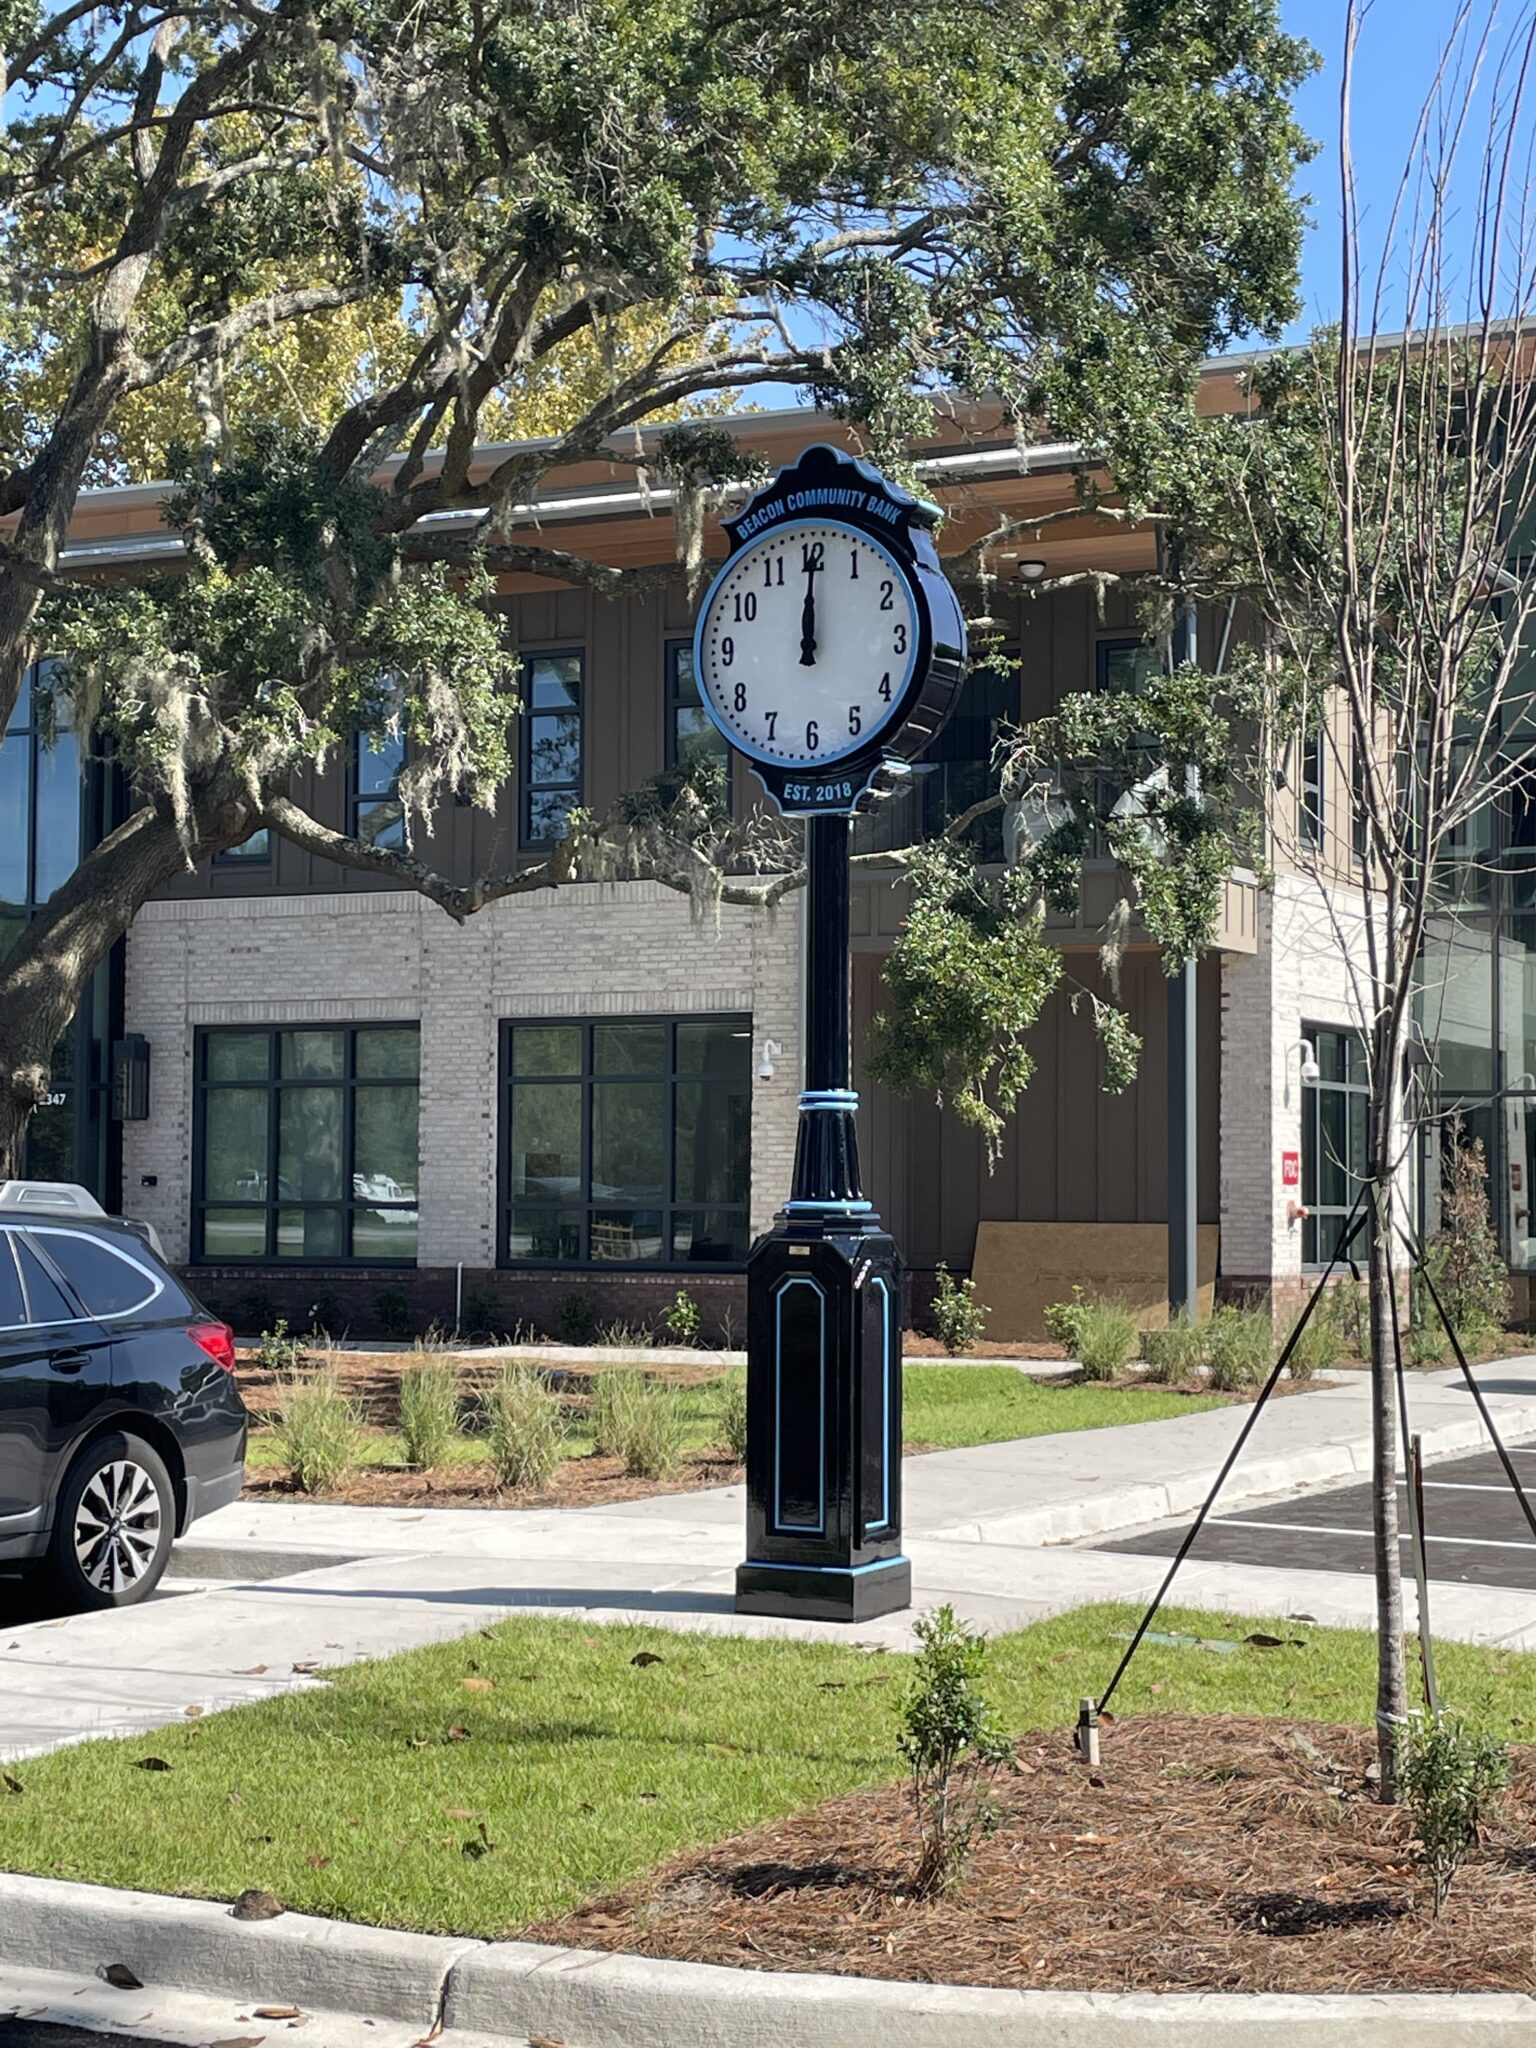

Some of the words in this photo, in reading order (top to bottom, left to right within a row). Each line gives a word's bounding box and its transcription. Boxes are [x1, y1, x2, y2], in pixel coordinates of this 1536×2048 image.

[736, 499, 785, 540] BEACON
[787, 488, 867, 511] COMMUNITY
[866, 496, 902, 525] BANK
[764, 556, 784, 587] 11
[801, 542, 824, 573] 12
[850, 549, 858, 579] 1
[734, 592, 757, 622] 10
[880, 580, 893, 610] 2
[721, 637, 734, 667] 9
[893, 624, 906, 655] 3
[734, 683, 746, 712] 8
[878, 672, 891, 702] 4
[765, 712, 778, 741] 7
[806, 721, 819, 751] 6
[849, 706, 861, 736] 5
[783, 783, 811, 801] EST.
[816, 782, 852, 801] 2018
